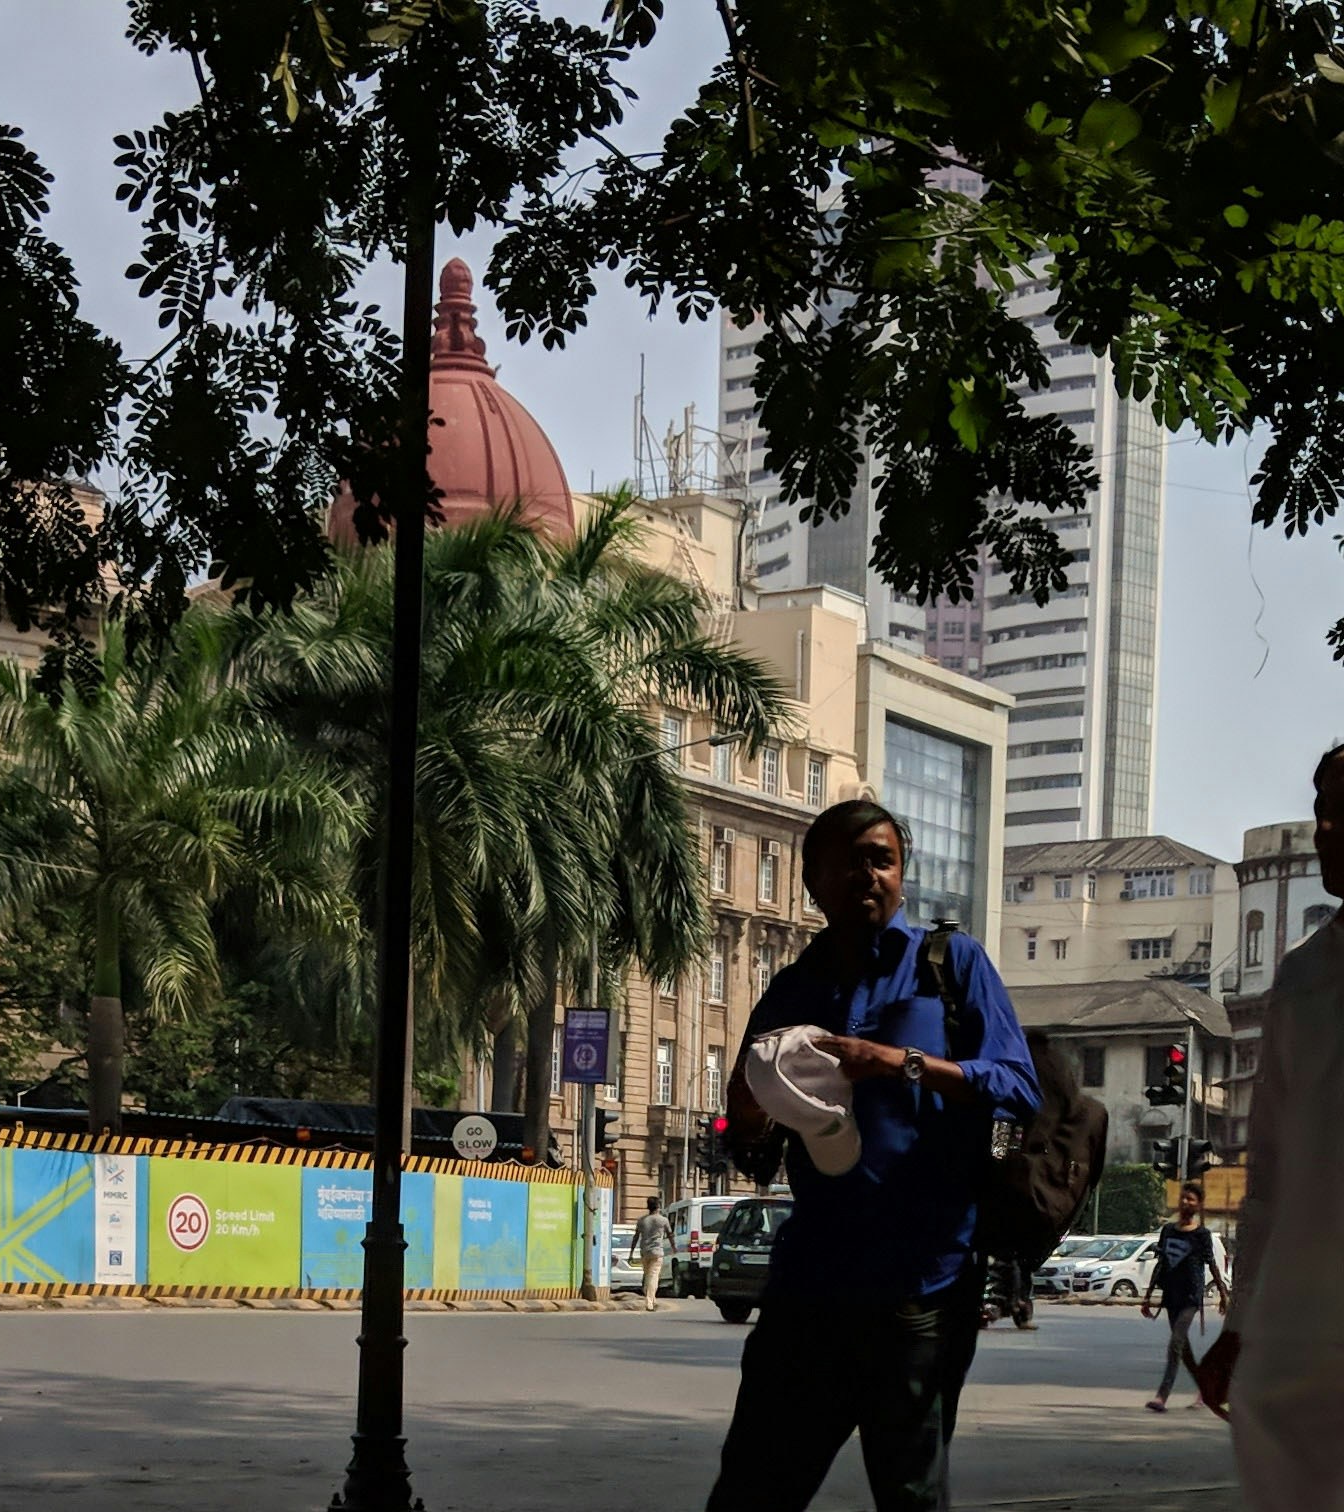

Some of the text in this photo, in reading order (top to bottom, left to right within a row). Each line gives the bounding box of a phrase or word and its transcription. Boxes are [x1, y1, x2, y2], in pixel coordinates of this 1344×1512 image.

[466, 1127, 483, 1136] GO
[457, 1140, 493, 1149] SLOW
[103, 1191, 128, 1200] MMRC
[215, 1209, 275, 1222] Speed Limit
[176, 1211, 202, 1233] 20
[216, 1223, 260, 1236] 20 Km/h
